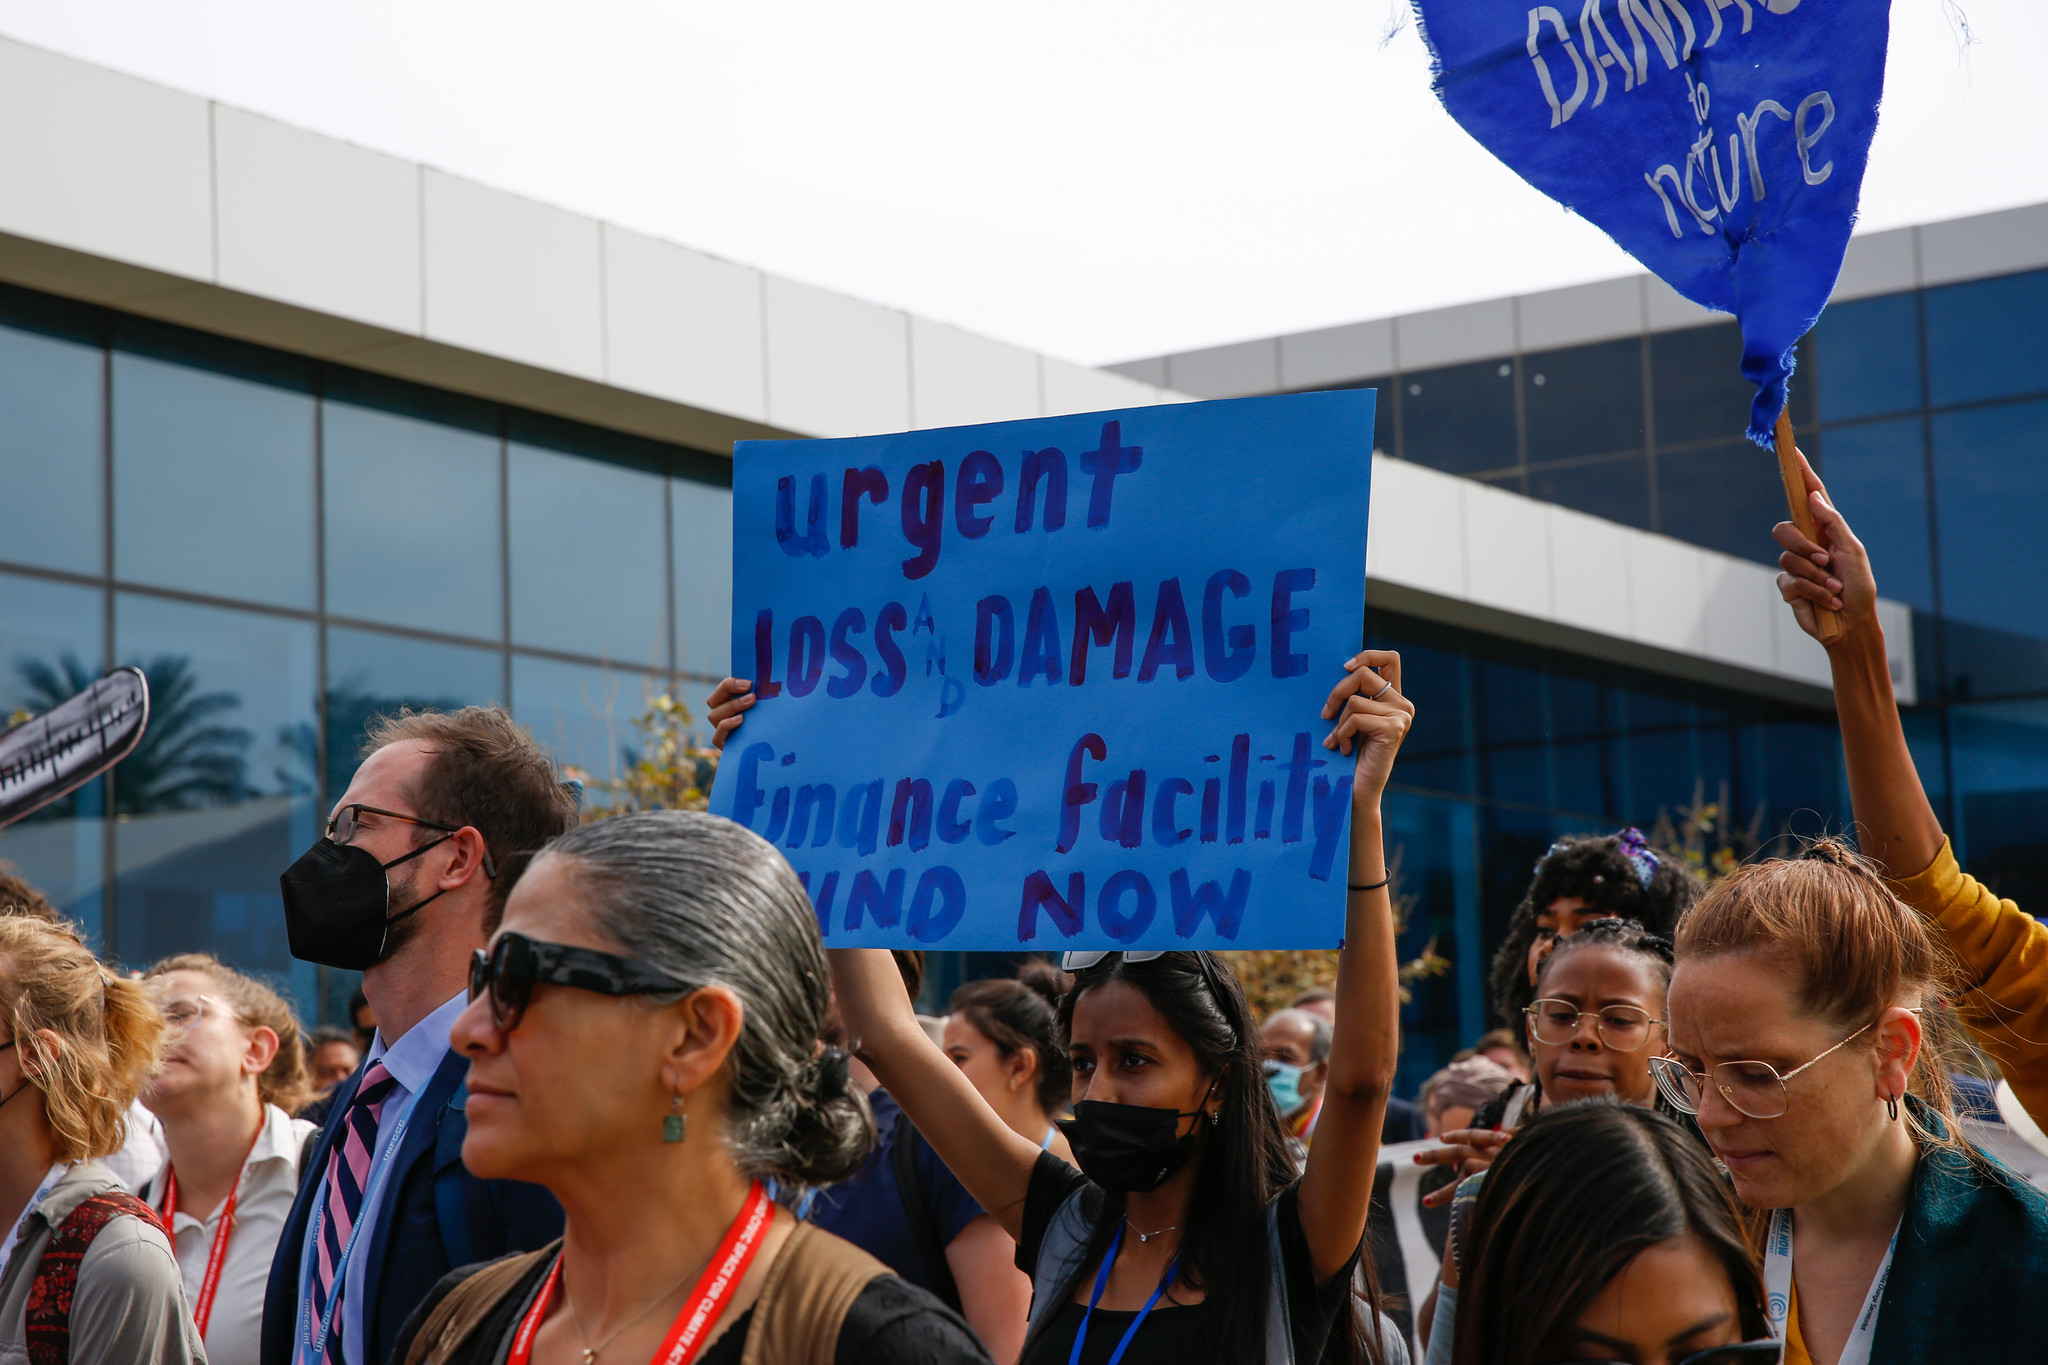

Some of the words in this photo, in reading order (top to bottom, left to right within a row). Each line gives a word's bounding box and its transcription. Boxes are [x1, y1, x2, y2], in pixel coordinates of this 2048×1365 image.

[1527, 0, 1800, 129] DAM
[1684, 72, 1710, 126] to
[775, 420, 1144, 580] urgent
[755, 602, 908, 700] LOSS
[973, 567, 1317, 688] DAMAGE
[732, 741, 1018, 857] finance
[1055, 733, 1354, 883] facility
[798, 865, 967, 943] UND
[1017, 867, 1252, 945] NOW
[383, 1119, 406, 1162] UNFCCC
[719, 1241, 748, 1279] SPACE
[707, 1275, 729, 1301] FOR
[303, 1298, 312, 1345] unfccc.int
[314, 1310, 331, 1353] UNFCCC
[678, 1297, 715, 1348] CLIMATE
